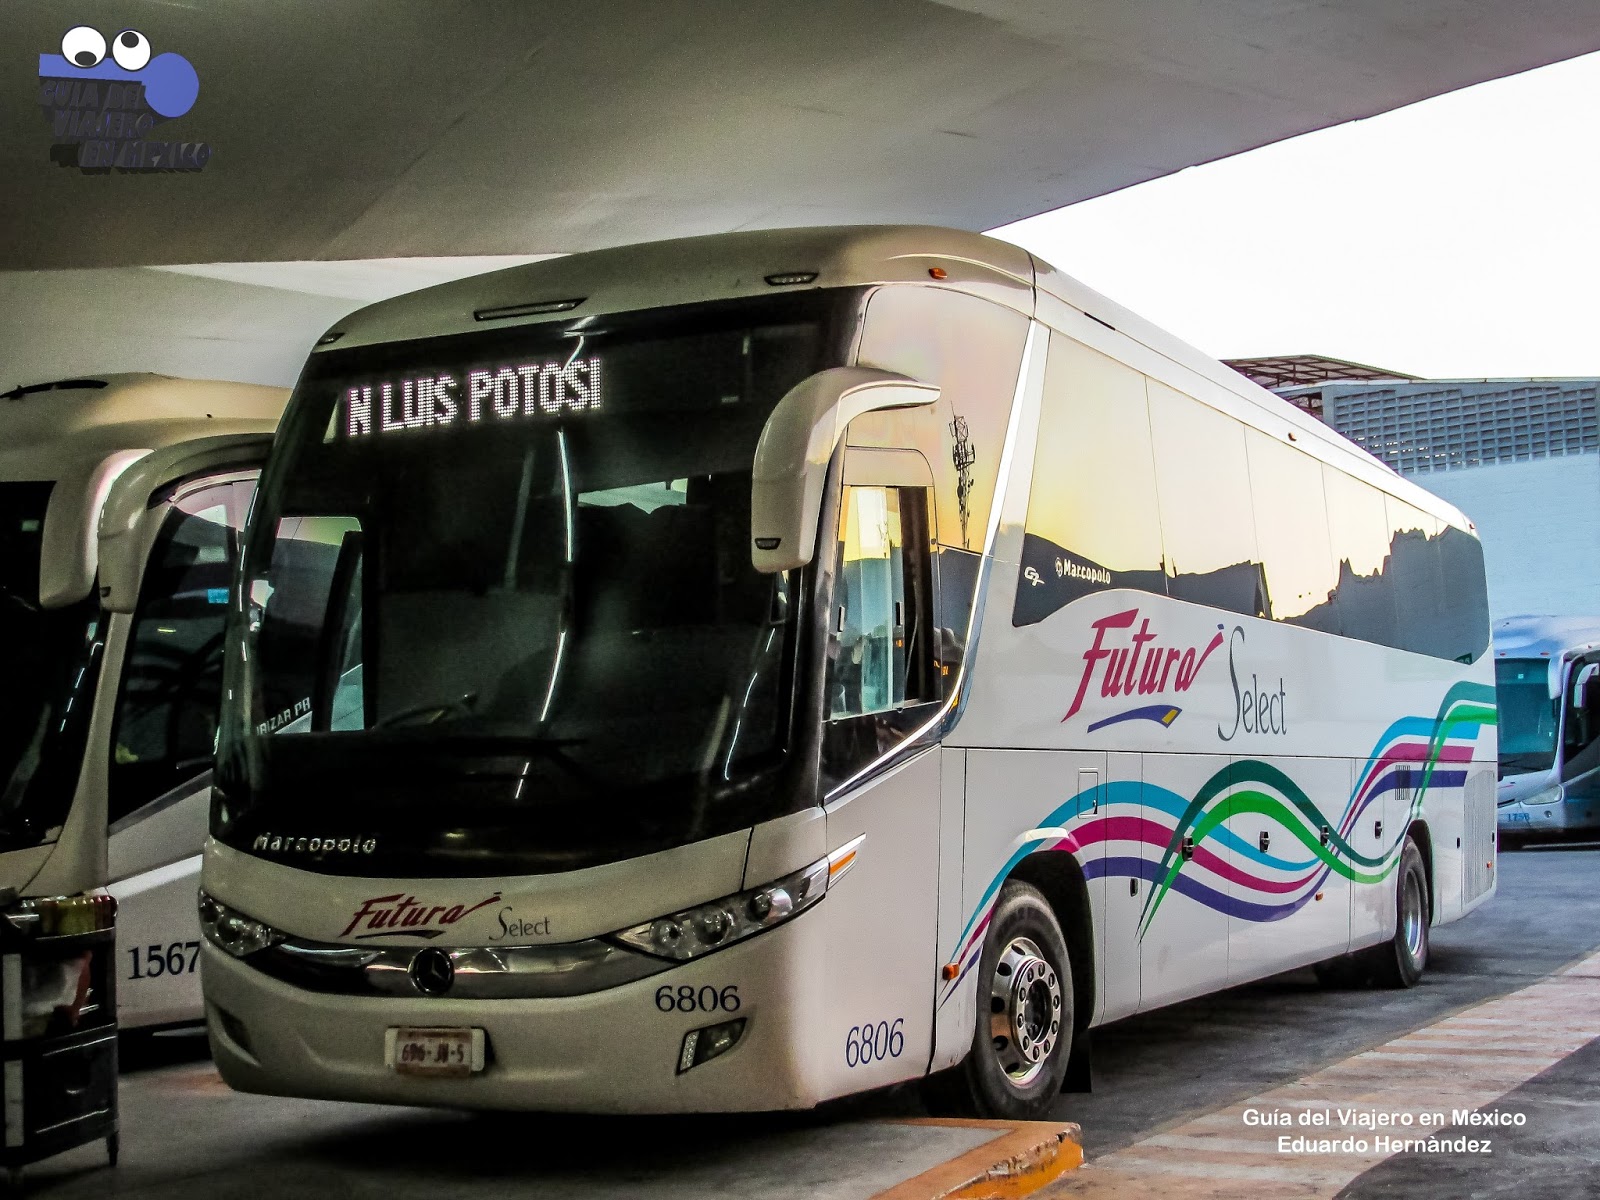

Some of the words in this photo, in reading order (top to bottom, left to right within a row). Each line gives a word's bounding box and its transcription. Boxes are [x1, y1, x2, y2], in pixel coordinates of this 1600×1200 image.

[381, 374, 458, 431] LUIS
[467, 356, 601, 422] POTOSI
[1063, 558, 1111, 585] Marcopolo
[1061, 608, 1224, 723] Futura
[1218, 626, 1287, 741] Select
[253, 832, 376, 853] Marcopolo
[338, 892, 502, 938] Futura
[489, 906, 550, 941] Select
[128, 941, 200, 980] 1567
[655, 985, 741, 1012] 6806
[845, 1017, 904, 1068] 6806
